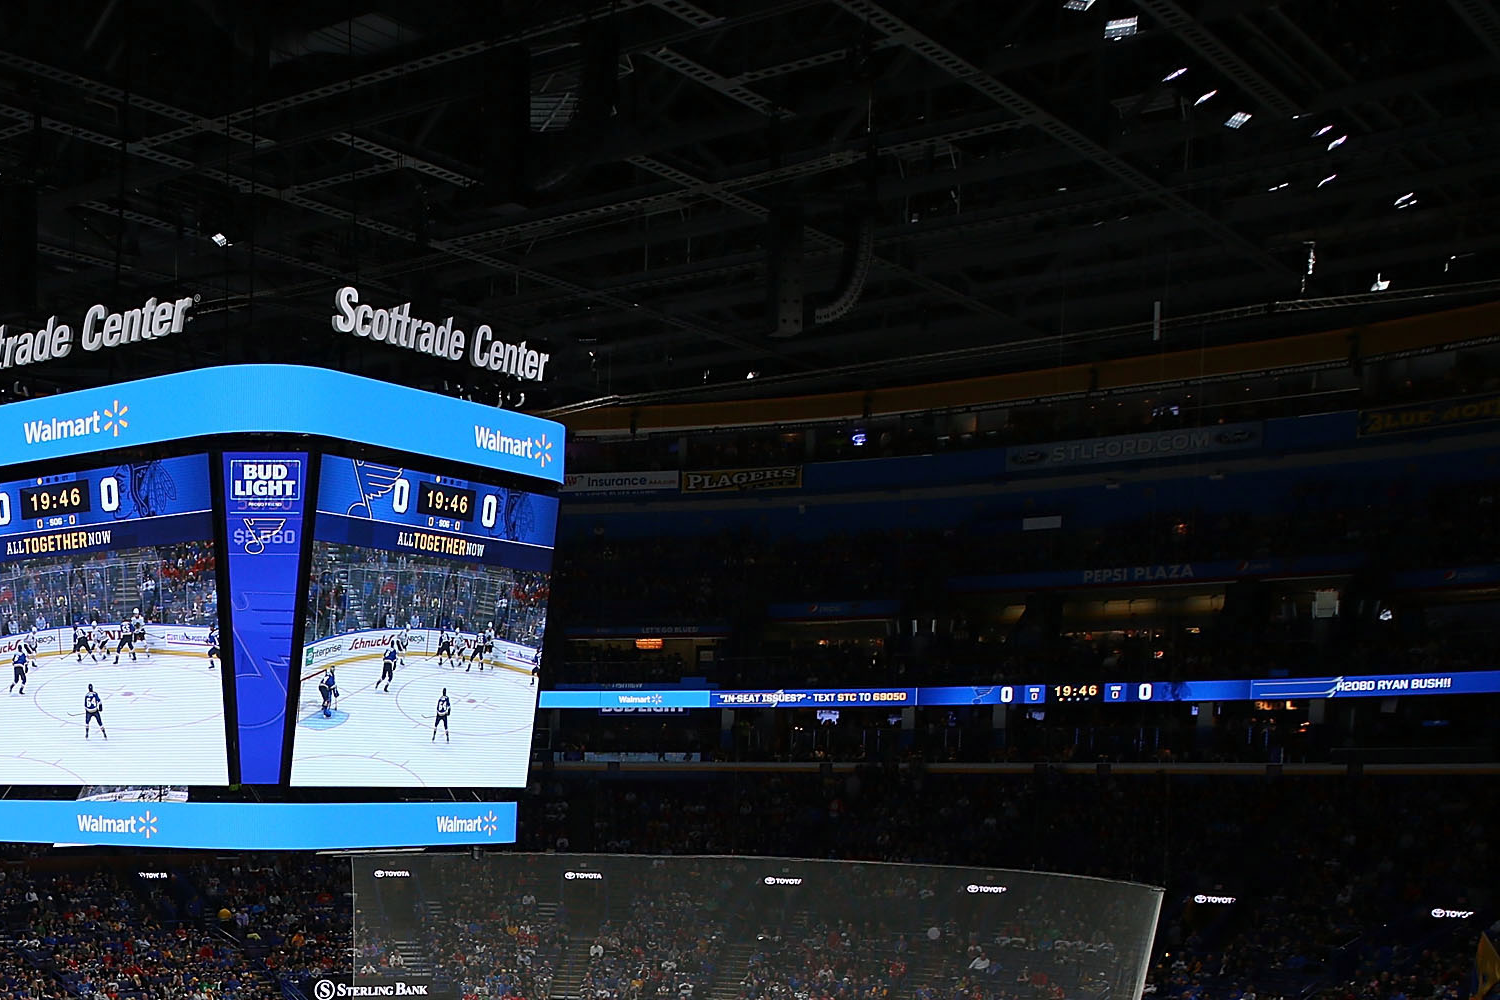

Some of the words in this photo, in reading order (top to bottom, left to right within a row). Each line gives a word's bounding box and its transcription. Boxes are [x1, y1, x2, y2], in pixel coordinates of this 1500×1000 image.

[81, 298, 192, 351] Center
[333, 286, 465, 360] Scottrade
[471, 324, 550, 381] Center
[23, 411, 101, 445] Walmart
[474, 425, 534, 459] Walmart
[1051, 433, 1211, 463] STLFORD.COM
[243, 464, 288, 480] BUD
[687, 467, 798, 491] PLAGERS
[587, 477, 648, 488] Insurance
[30, 488, 82, 512] 19:46
[99, 476, 120, 512] 0
[393, 479, 411, 514] 0
[427, 490, 468, 514] 19:46
[481, 495, 498, 528] 0
[1084, 567, 1130, 584] PEPSI
[1133, 563, 1196, 581] PLAZA
[1054, 684, 1098, 697] 19:46
[1138, 683, 1152, 700] 0
[1377, 679, 1405, 691] RYAN
[1410, 677, 1452, 690] BUSH!!
[618, 695, 651, 704] Walmart
[813, 693, 836, 702] TEXT
[837, 693, 857, 702] STC
[859, 693, 871, 701] TO
[872, 691, 907, 701] 69050
[1000, 686, 1014, 703] 0
[76, 814, 137, 834] Walmart
[436, 815, 483, 834] Walmart
[385, 871, 411, 879] TOYOTA
[575, 872, 603, 880] TOYOTA
